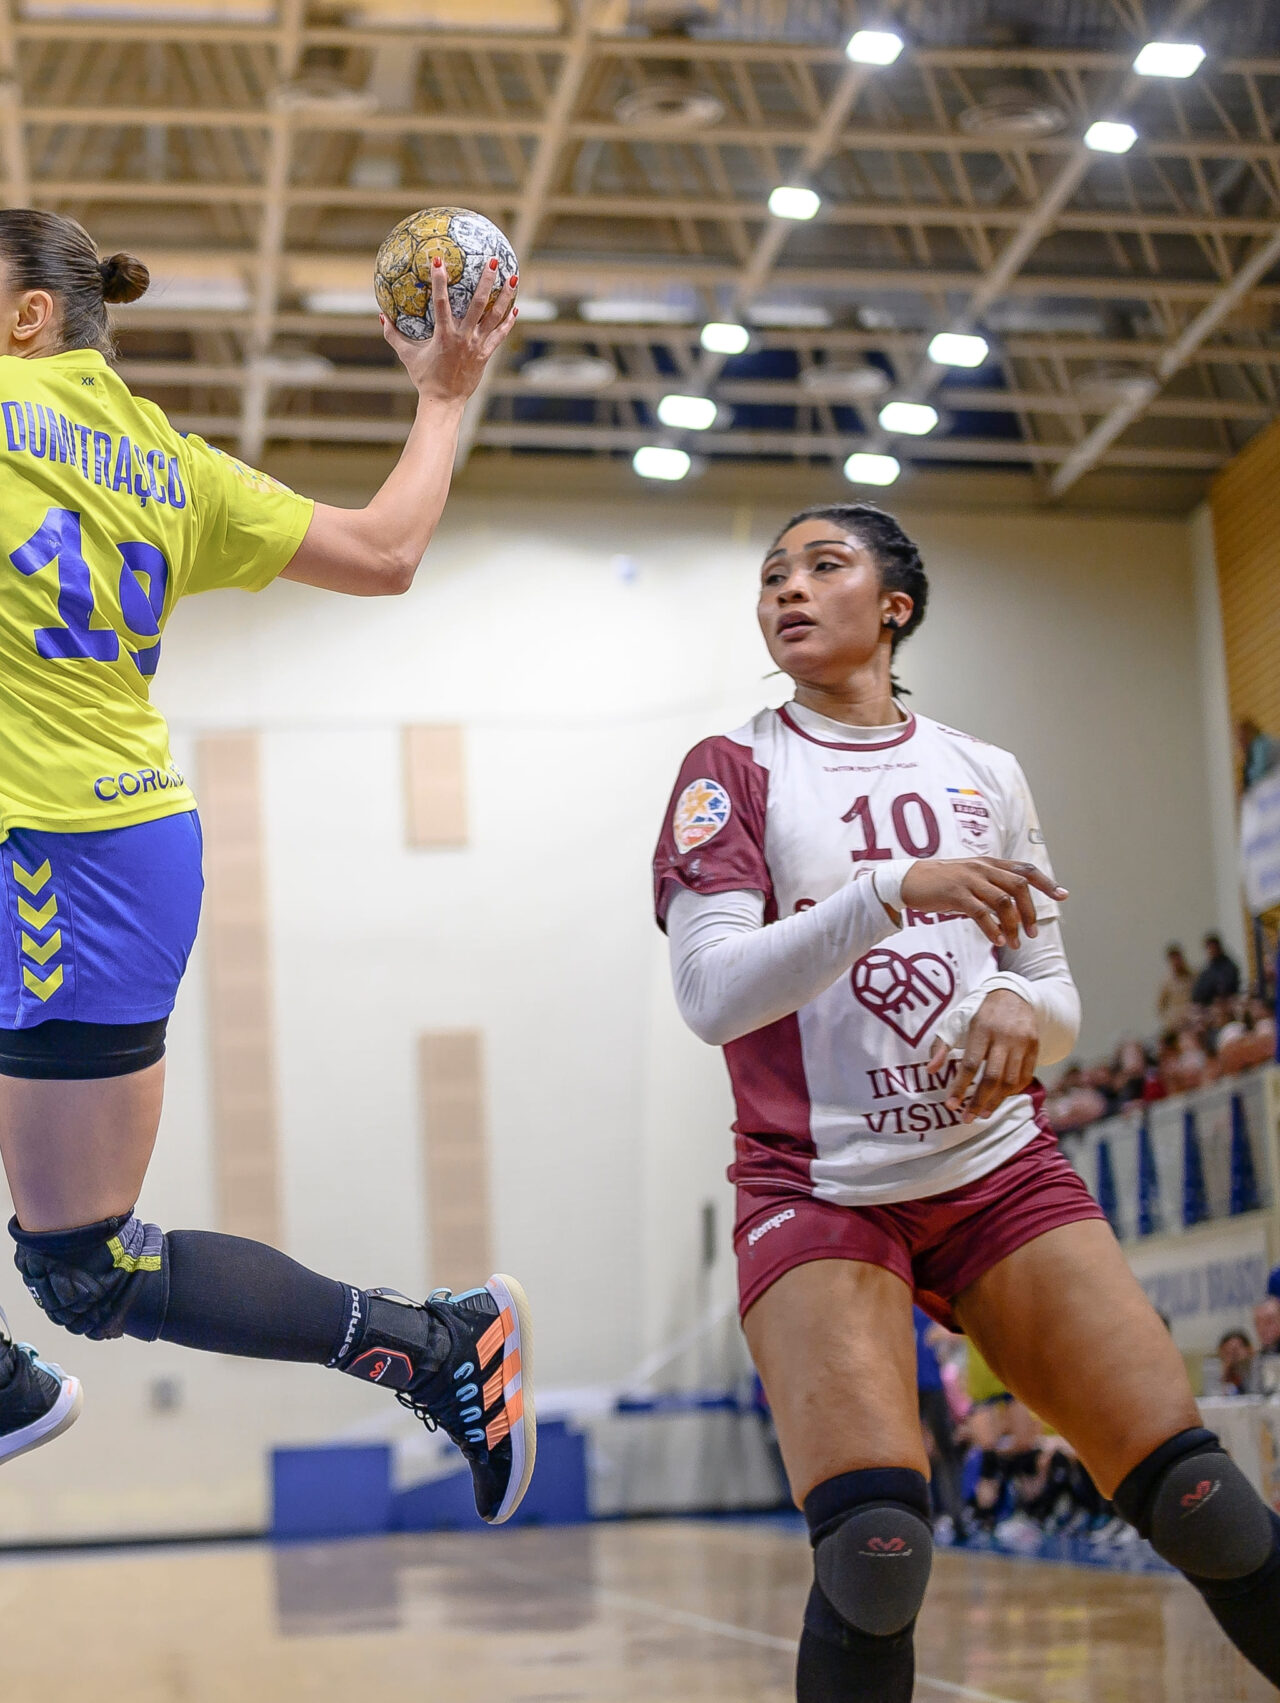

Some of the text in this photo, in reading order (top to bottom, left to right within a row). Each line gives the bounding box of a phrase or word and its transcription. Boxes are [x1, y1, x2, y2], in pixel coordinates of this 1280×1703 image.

[9, 507, 168, 675] 19
[841, 792, 940, 862] 10
[866, 1059, 966, 1099] INIM
[748, 1208, 796, 1246] Kempa
[328, 1288, 362, 1367] empa
